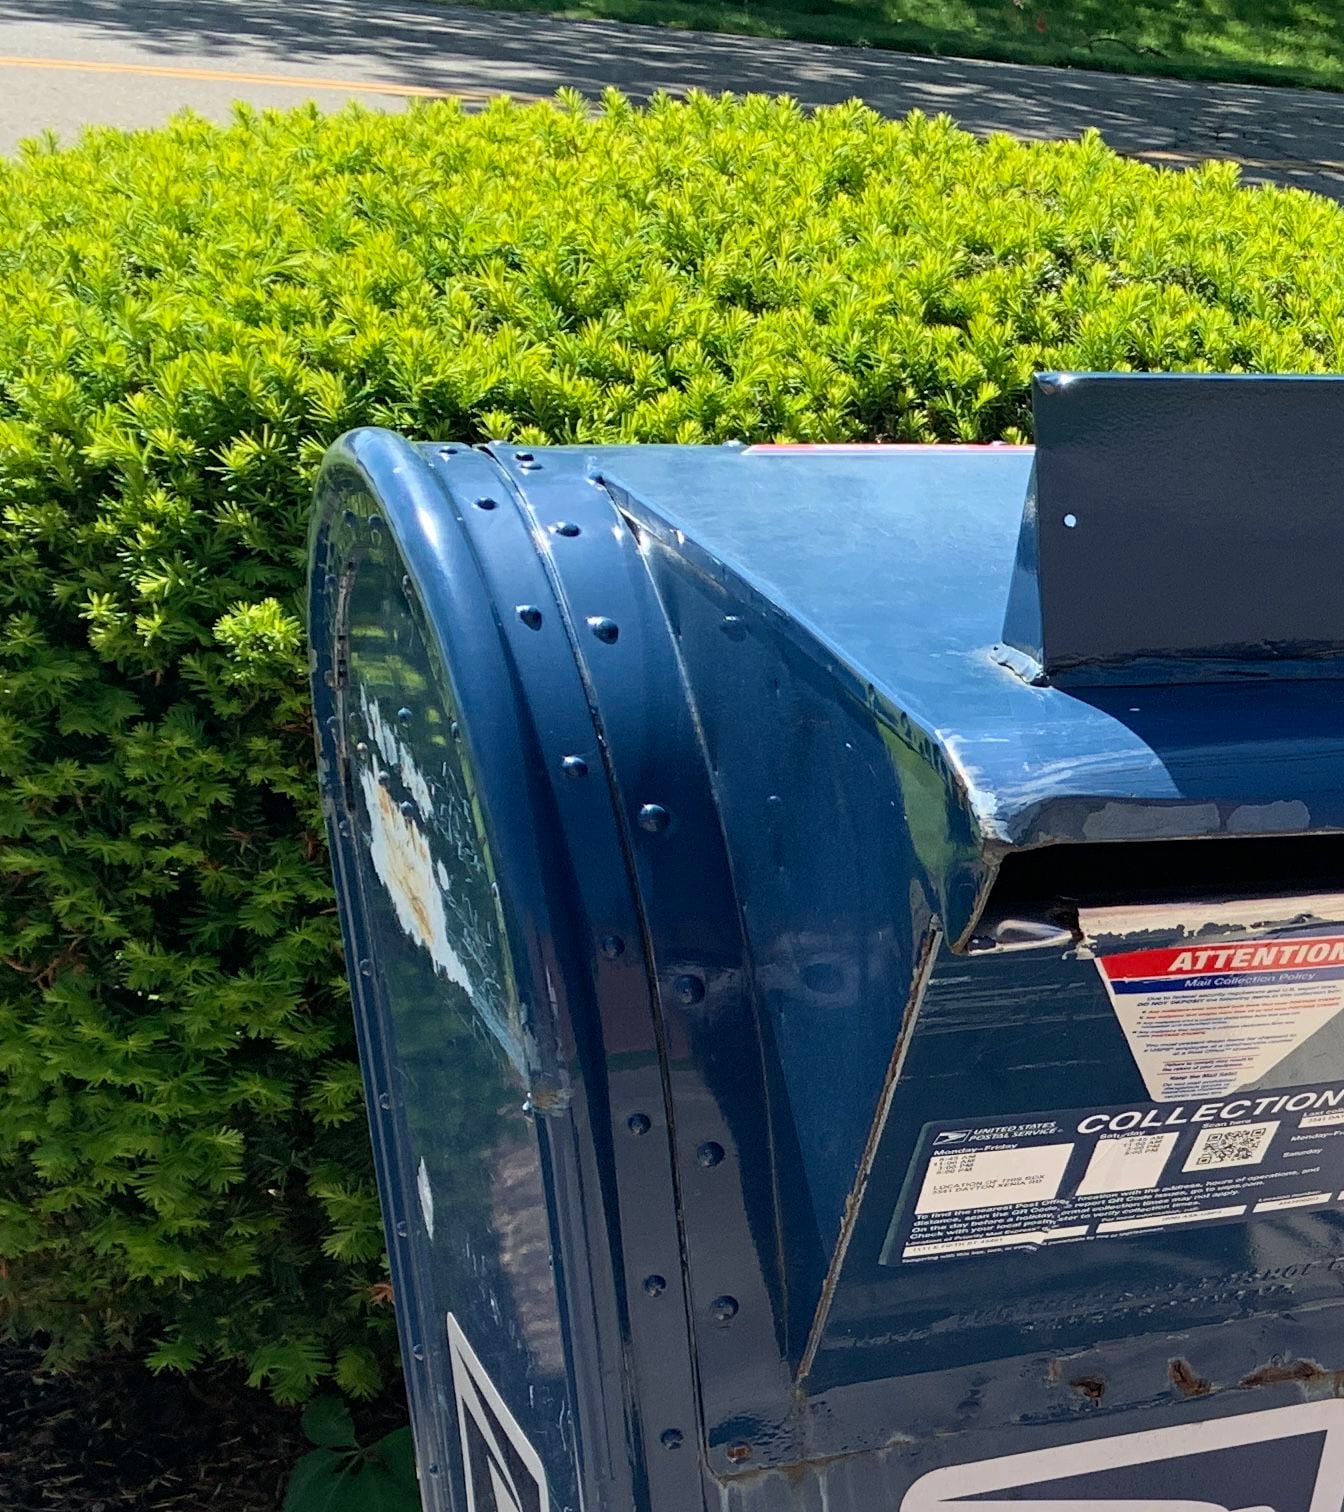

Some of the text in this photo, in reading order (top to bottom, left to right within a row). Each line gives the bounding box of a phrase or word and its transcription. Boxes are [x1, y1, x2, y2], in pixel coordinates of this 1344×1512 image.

[1184, 972, 1315, 988] Mail Collection Policy
[967, 1127, 1057, 1141] POSTAL SERVICE
[972, 1121, 1056, 1134] UNITED STATES
[1282, 1148, 1322, 1157] Saturday
[970, 1218, 1004, 1226] before
[1092, 1201, 1141, 1211] collection
[973, 1205, 1012, 1213] nearest
[909, 1230, 943, 1239] Check
[1121, 1204, 1170, 1214] collection
